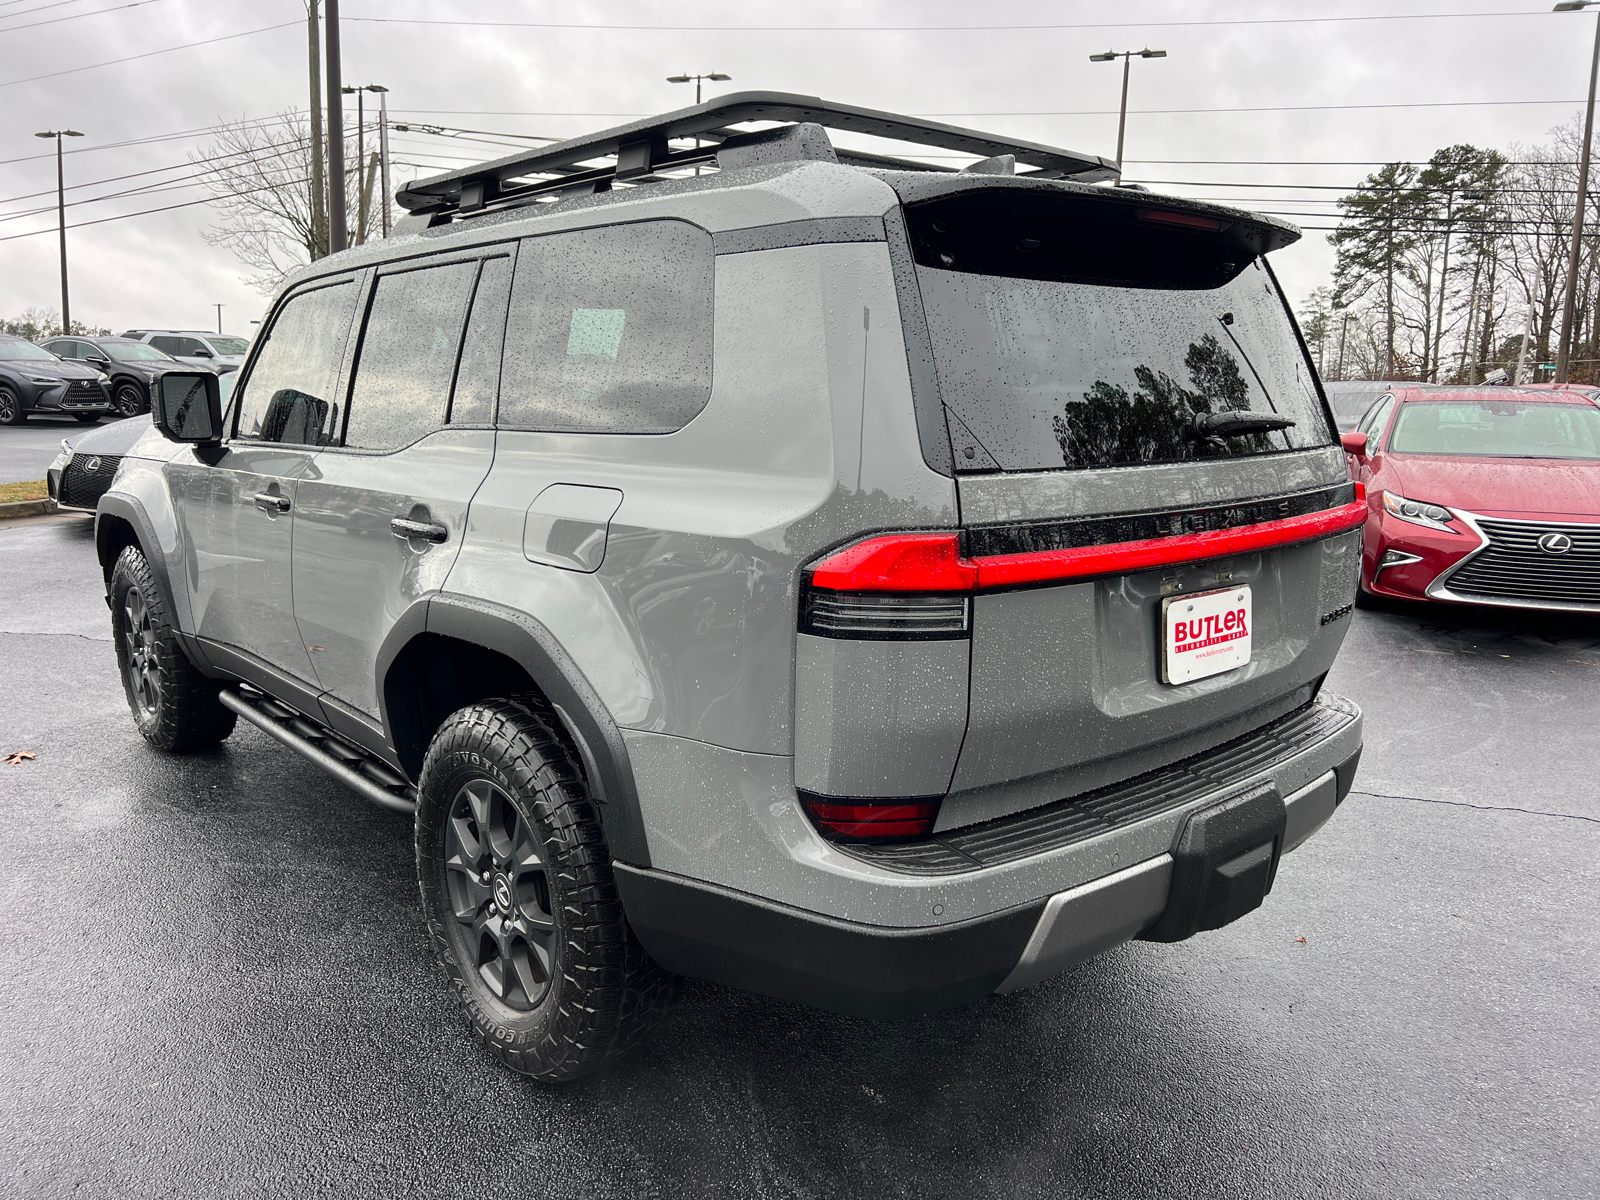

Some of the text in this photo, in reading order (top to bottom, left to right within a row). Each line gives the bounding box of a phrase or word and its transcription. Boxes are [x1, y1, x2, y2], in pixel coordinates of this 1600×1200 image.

[1155, 500, 1288, 533] LEXUS
[1175, 637, 1222, 653] AUTOMOTIVE
[1196, 646, 1234, 659] www.butlercars.com
[452, 977, 516, 1043] COUNTRY
